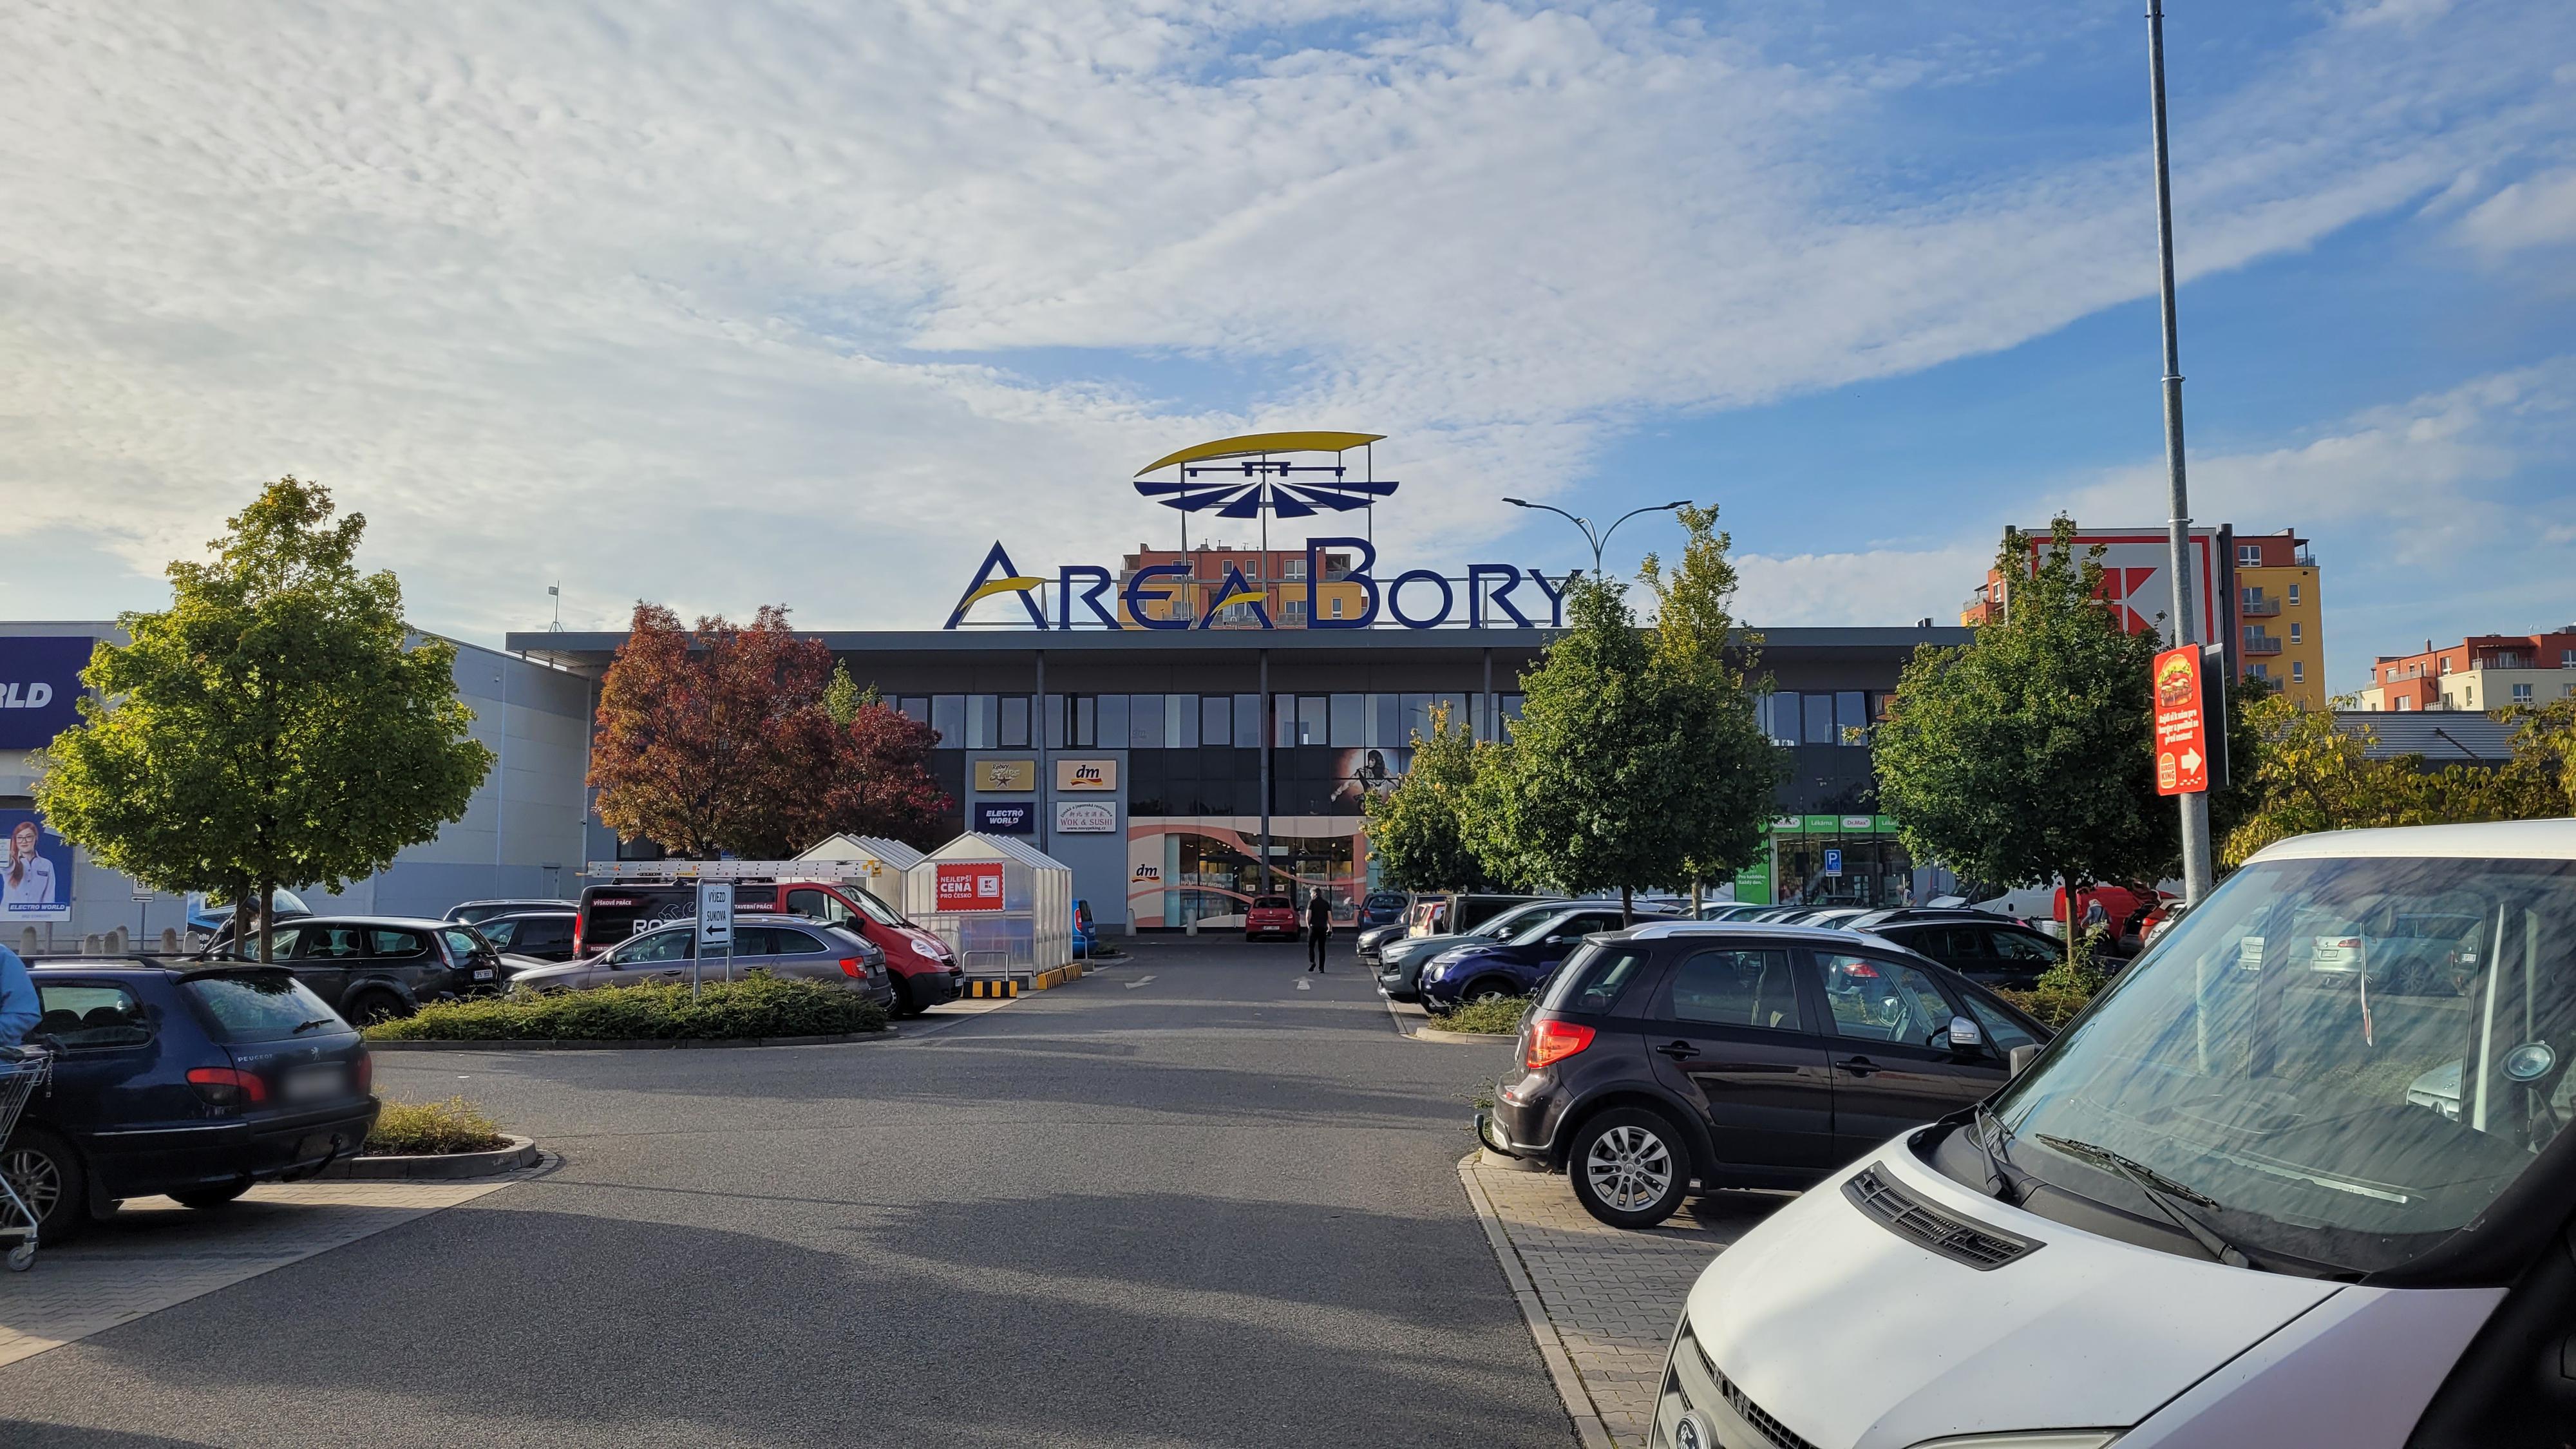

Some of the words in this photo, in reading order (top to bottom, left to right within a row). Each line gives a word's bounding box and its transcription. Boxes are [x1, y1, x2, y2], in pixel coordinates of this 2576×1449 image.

[1076, 764, 1099, 778] dm
[2161, 771, 2175, 781] KING
[1829, 853, 1837, 865] P
[1137, 864, 1157, 876] dm
[940, 883, 972, 892] CENA
[708, 889, 726, 903] VÝJEZD
[706, 911, 726, 922] SUKOVA
[238, 1054, 273, 1063] PEUGEOT
